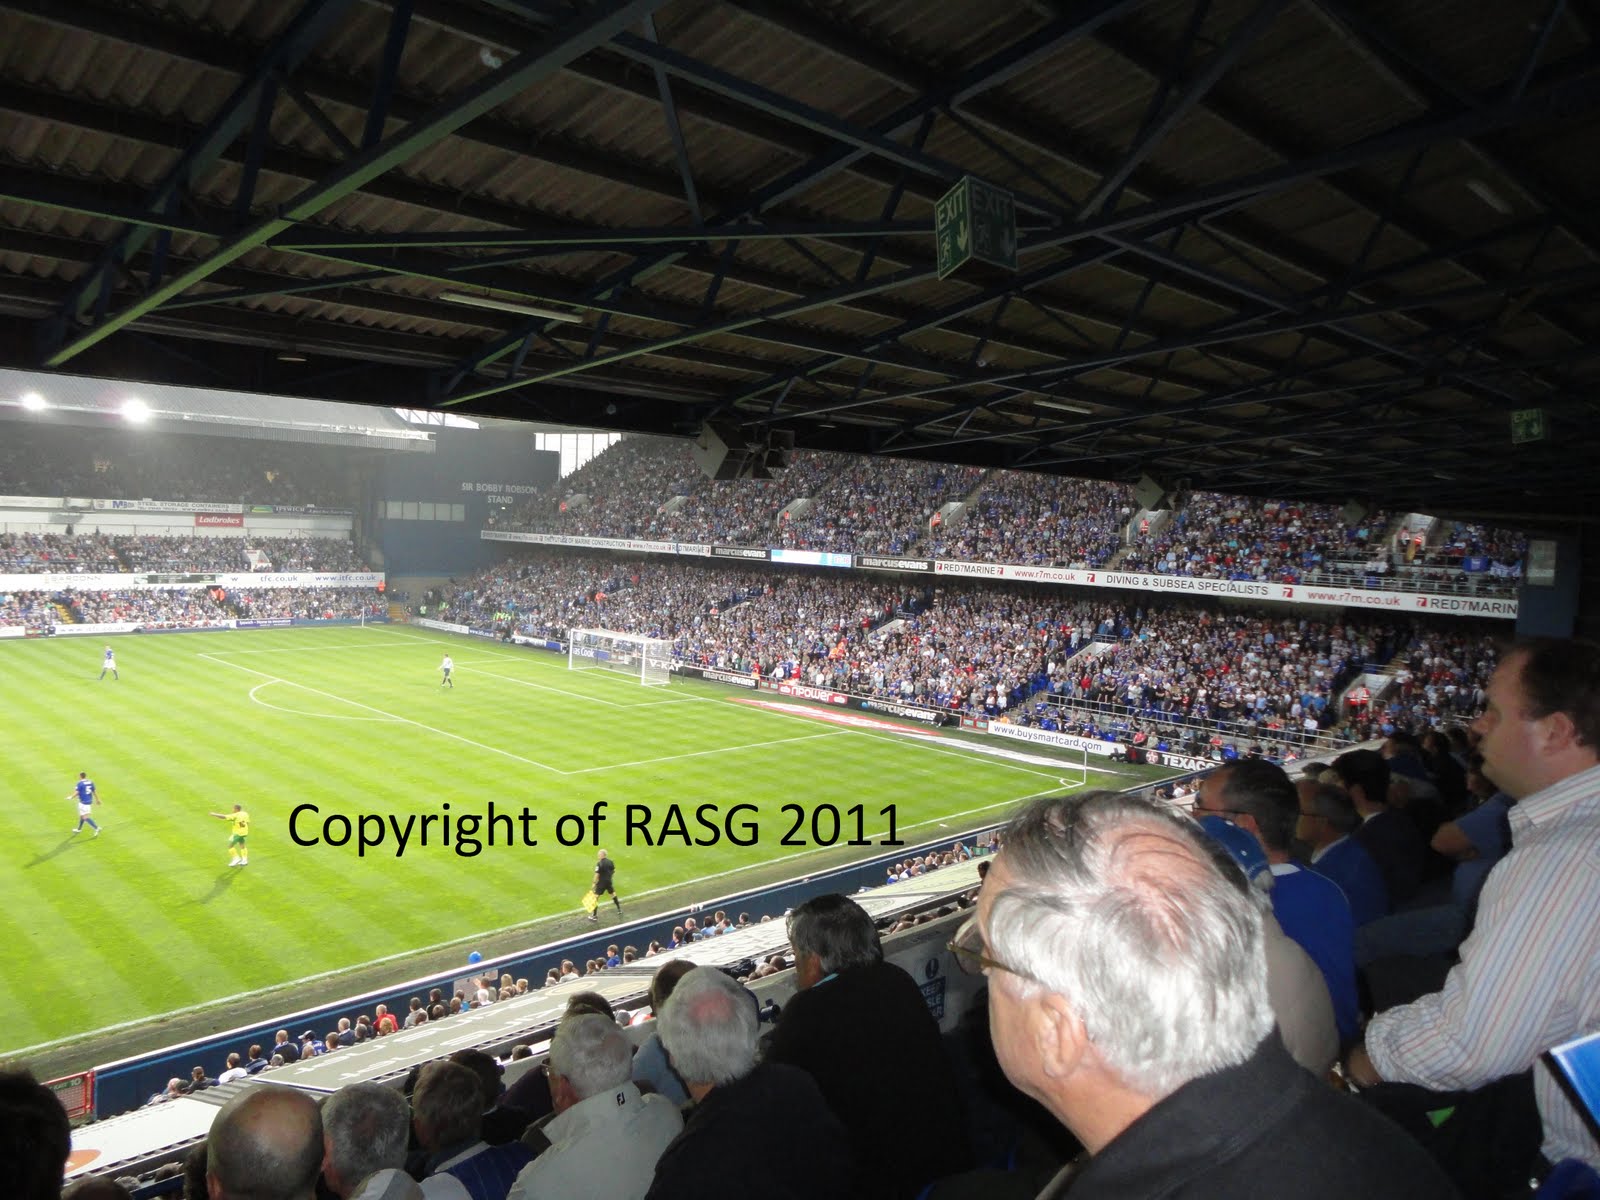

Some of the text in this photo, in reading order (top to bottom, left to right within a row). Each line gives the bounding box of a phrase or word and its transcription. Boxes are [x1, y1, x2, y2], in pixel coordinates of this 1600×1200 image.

[937, 184, 965, 231] EXIT
[971, 183, 1010, 223] EXIT
[461, 482, 538, 494] SIR BOBBY ROBSON
[487, 495, 514, 504] STAND
[199, 515, 240, 524] Ladbrokes
[592, 539, 626, 548] CONSTRUCTION
[715, 547, 766, 558] marcusevans
[862, 556, 928, 570] marcusevans
[315, 574, 377, 582] www.itfc.co.uk
[944, 563, 996, 575] RED7MARINE
[1014, 570, 1076, 581] www.r7m.co.uk
[1106, 574, 1139, 586] DIVING
[1142, 578, 1149, 586] &
[1152, 578, 1195, 590] SUBSEA
[1197, 581, 1268, 595] SPECIALISTS
[1308, 591, 1400, 605] www.r7m.co.uk
[703, 670, 756, 687] marcusevans
[791, 686, 833, 701] npower
[867, 700, 937, 721] marcusevans
[993, 724, 1102, 750] www.buysmartcard.com
